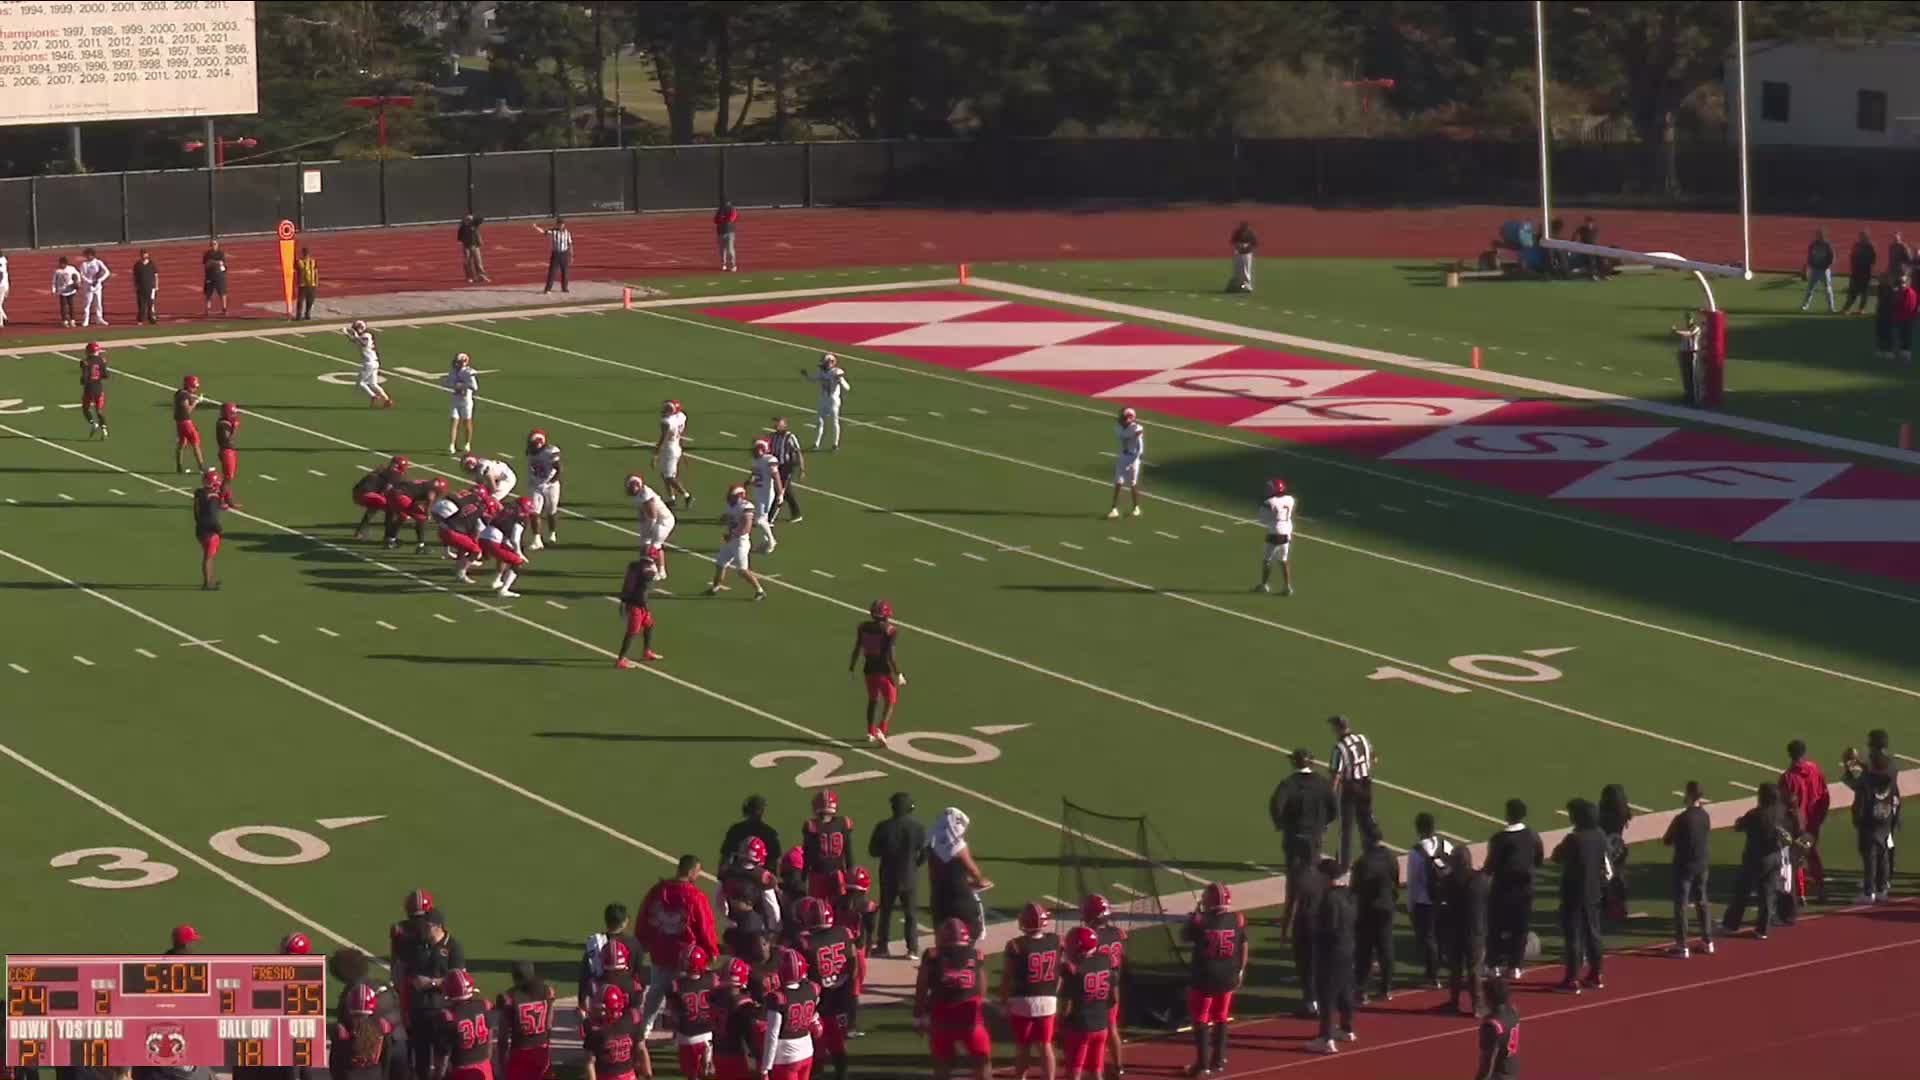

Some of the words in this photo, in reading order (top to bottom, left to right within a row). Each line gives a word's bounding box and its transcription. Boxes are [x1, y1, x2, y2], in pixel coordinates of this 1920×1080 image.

[205, 34, 228, 43] 2021
[1365, 654, 1563, 693] 10
[750, 731, 1001, 788] 20
[50, 825, 331, 889] 30
[817, 941, 847, 976] 65
[1028, 950, 1057, 982] 97
[1084, 970, 1110, 1000] 95
[457, 1012, 489, 1049] 34
[518, 1000, 548, 1035] 57
